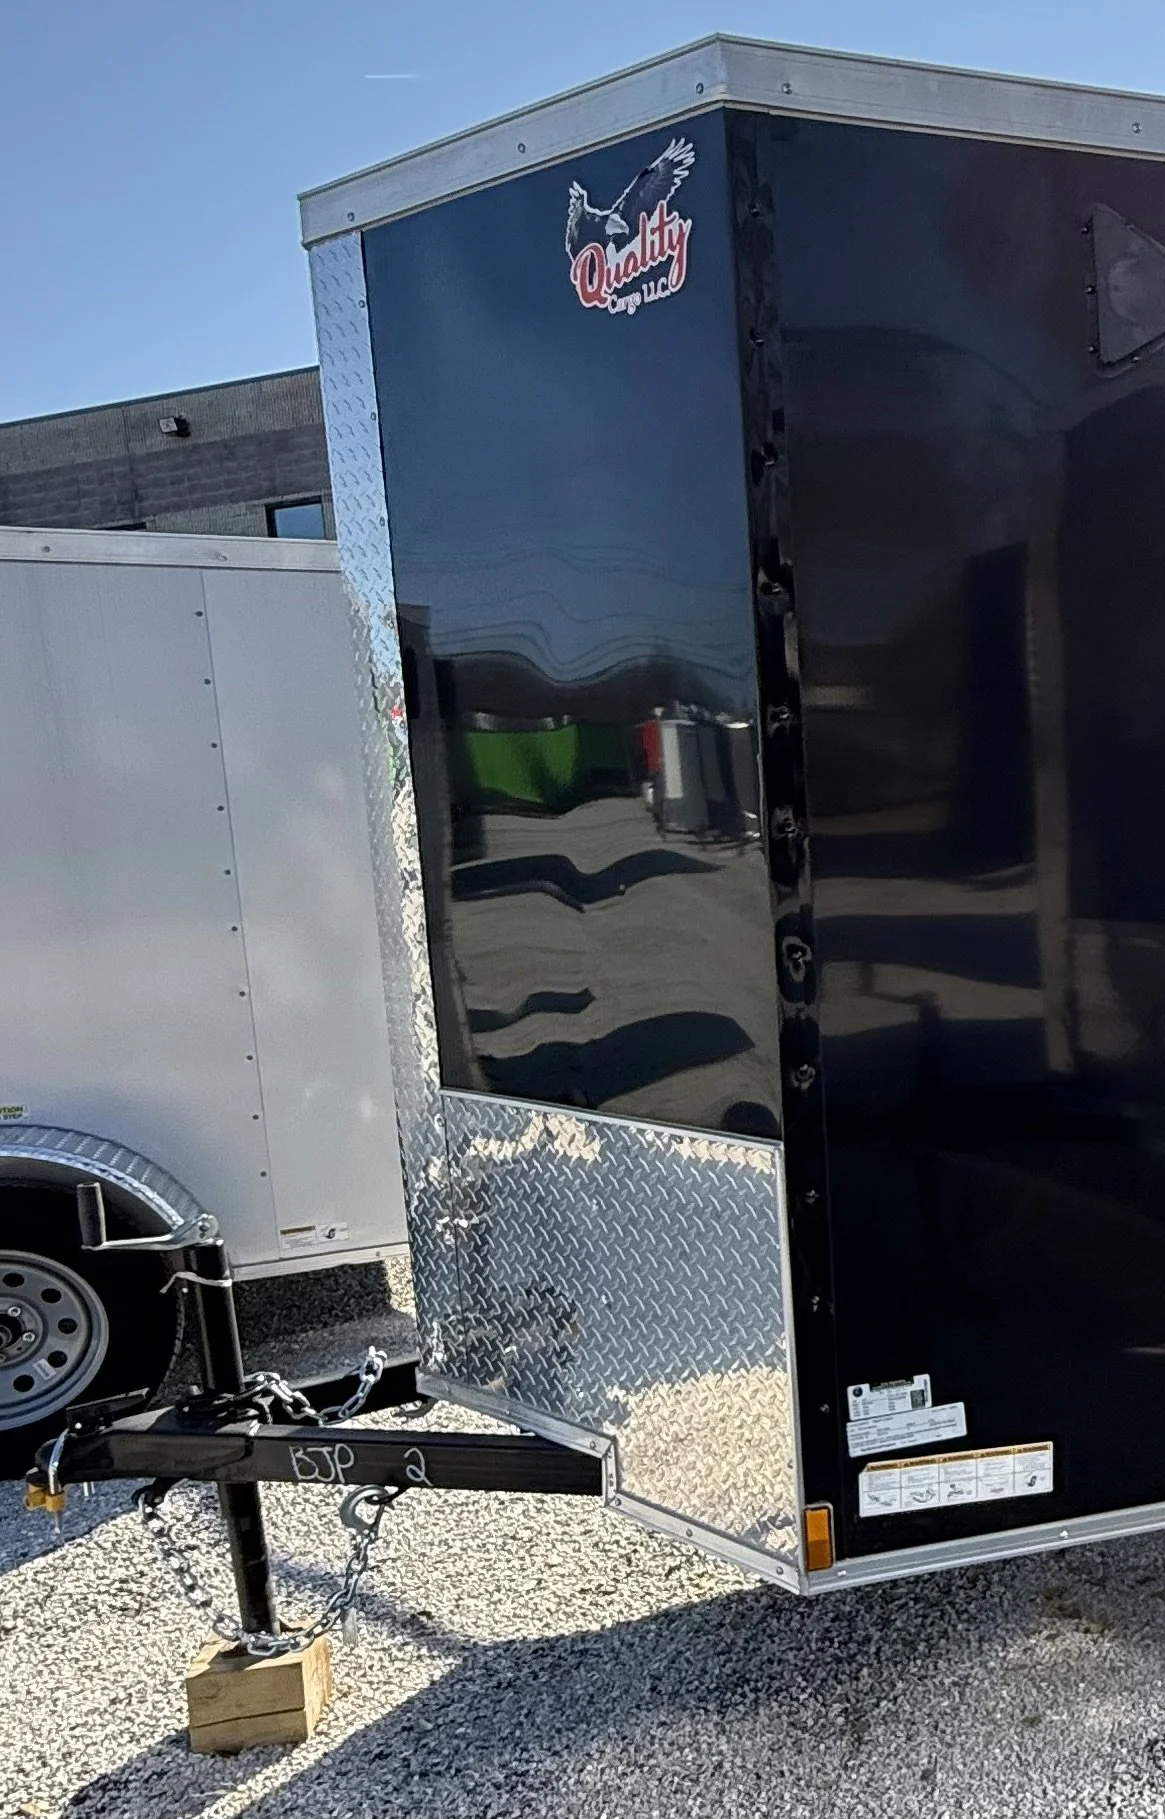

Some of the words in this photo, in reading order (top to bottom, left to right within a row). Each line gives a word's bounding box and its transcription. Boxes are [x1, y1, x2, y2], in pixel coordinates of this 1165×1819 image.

[571, 200, 692, 308] Quality
[608, 292, 642, 315] Cargo
[288, 1443, 355, 1484] BJP
